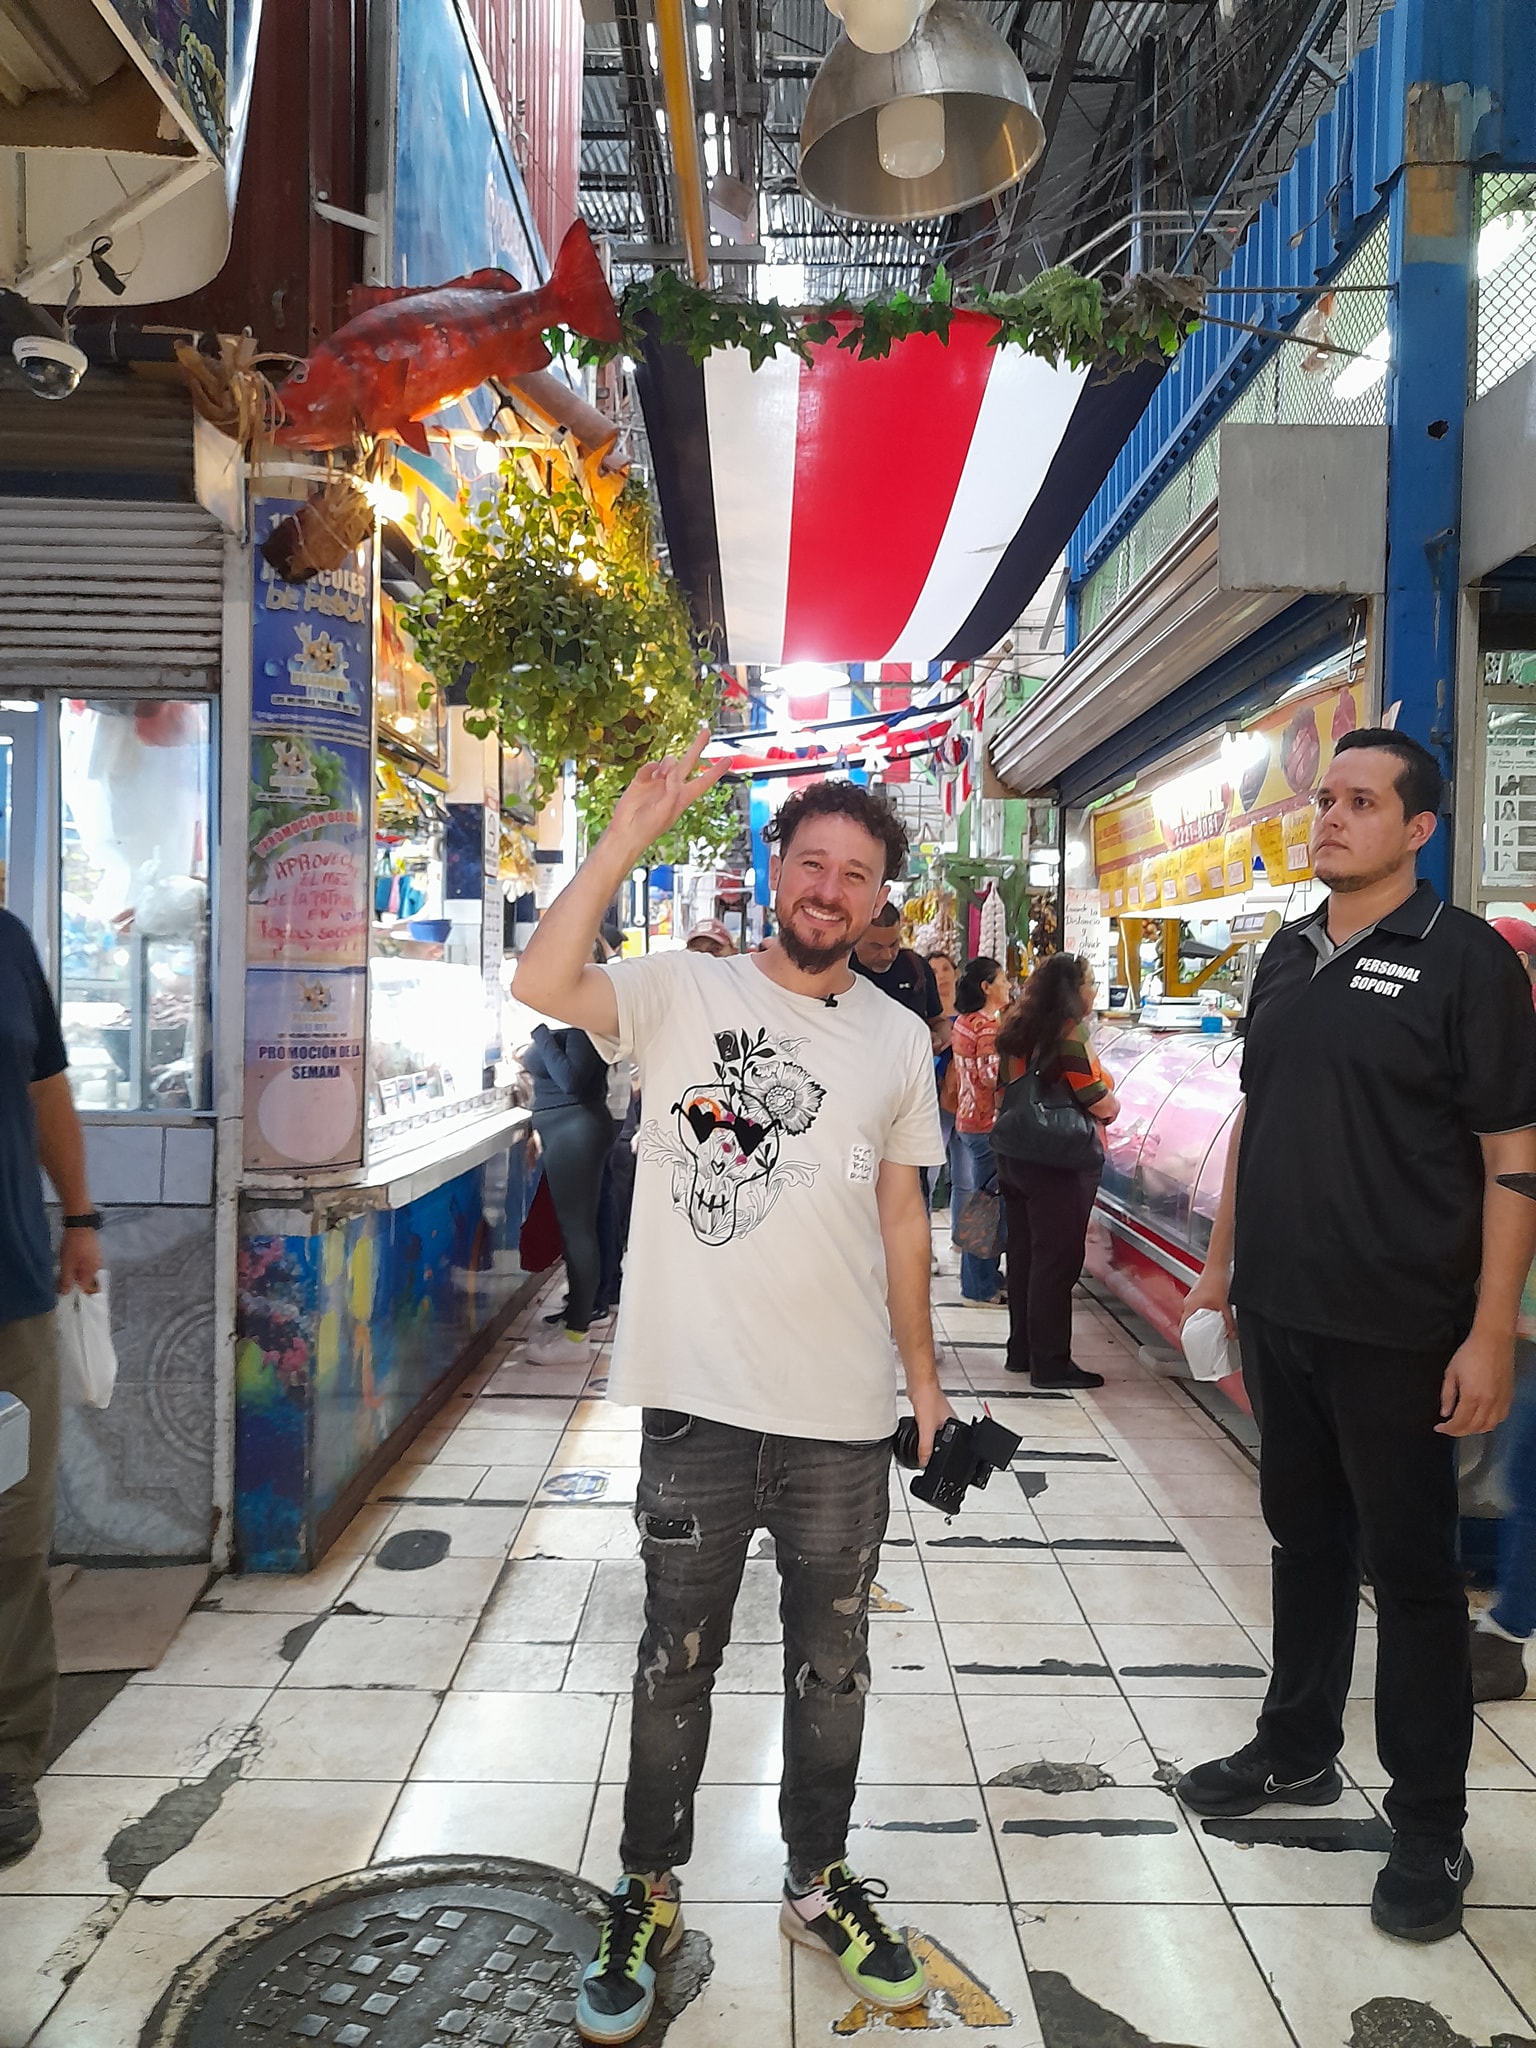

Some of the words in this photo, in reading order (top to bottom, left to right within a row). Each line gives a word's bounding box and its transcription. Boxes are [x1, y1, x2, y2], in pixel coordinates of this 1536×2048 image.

[1354, 957, 1421, 983] PERSONAL
[1349, 975, 1405, 998] SOPORT
[291, 1064, 341, 1081] SEMANA
